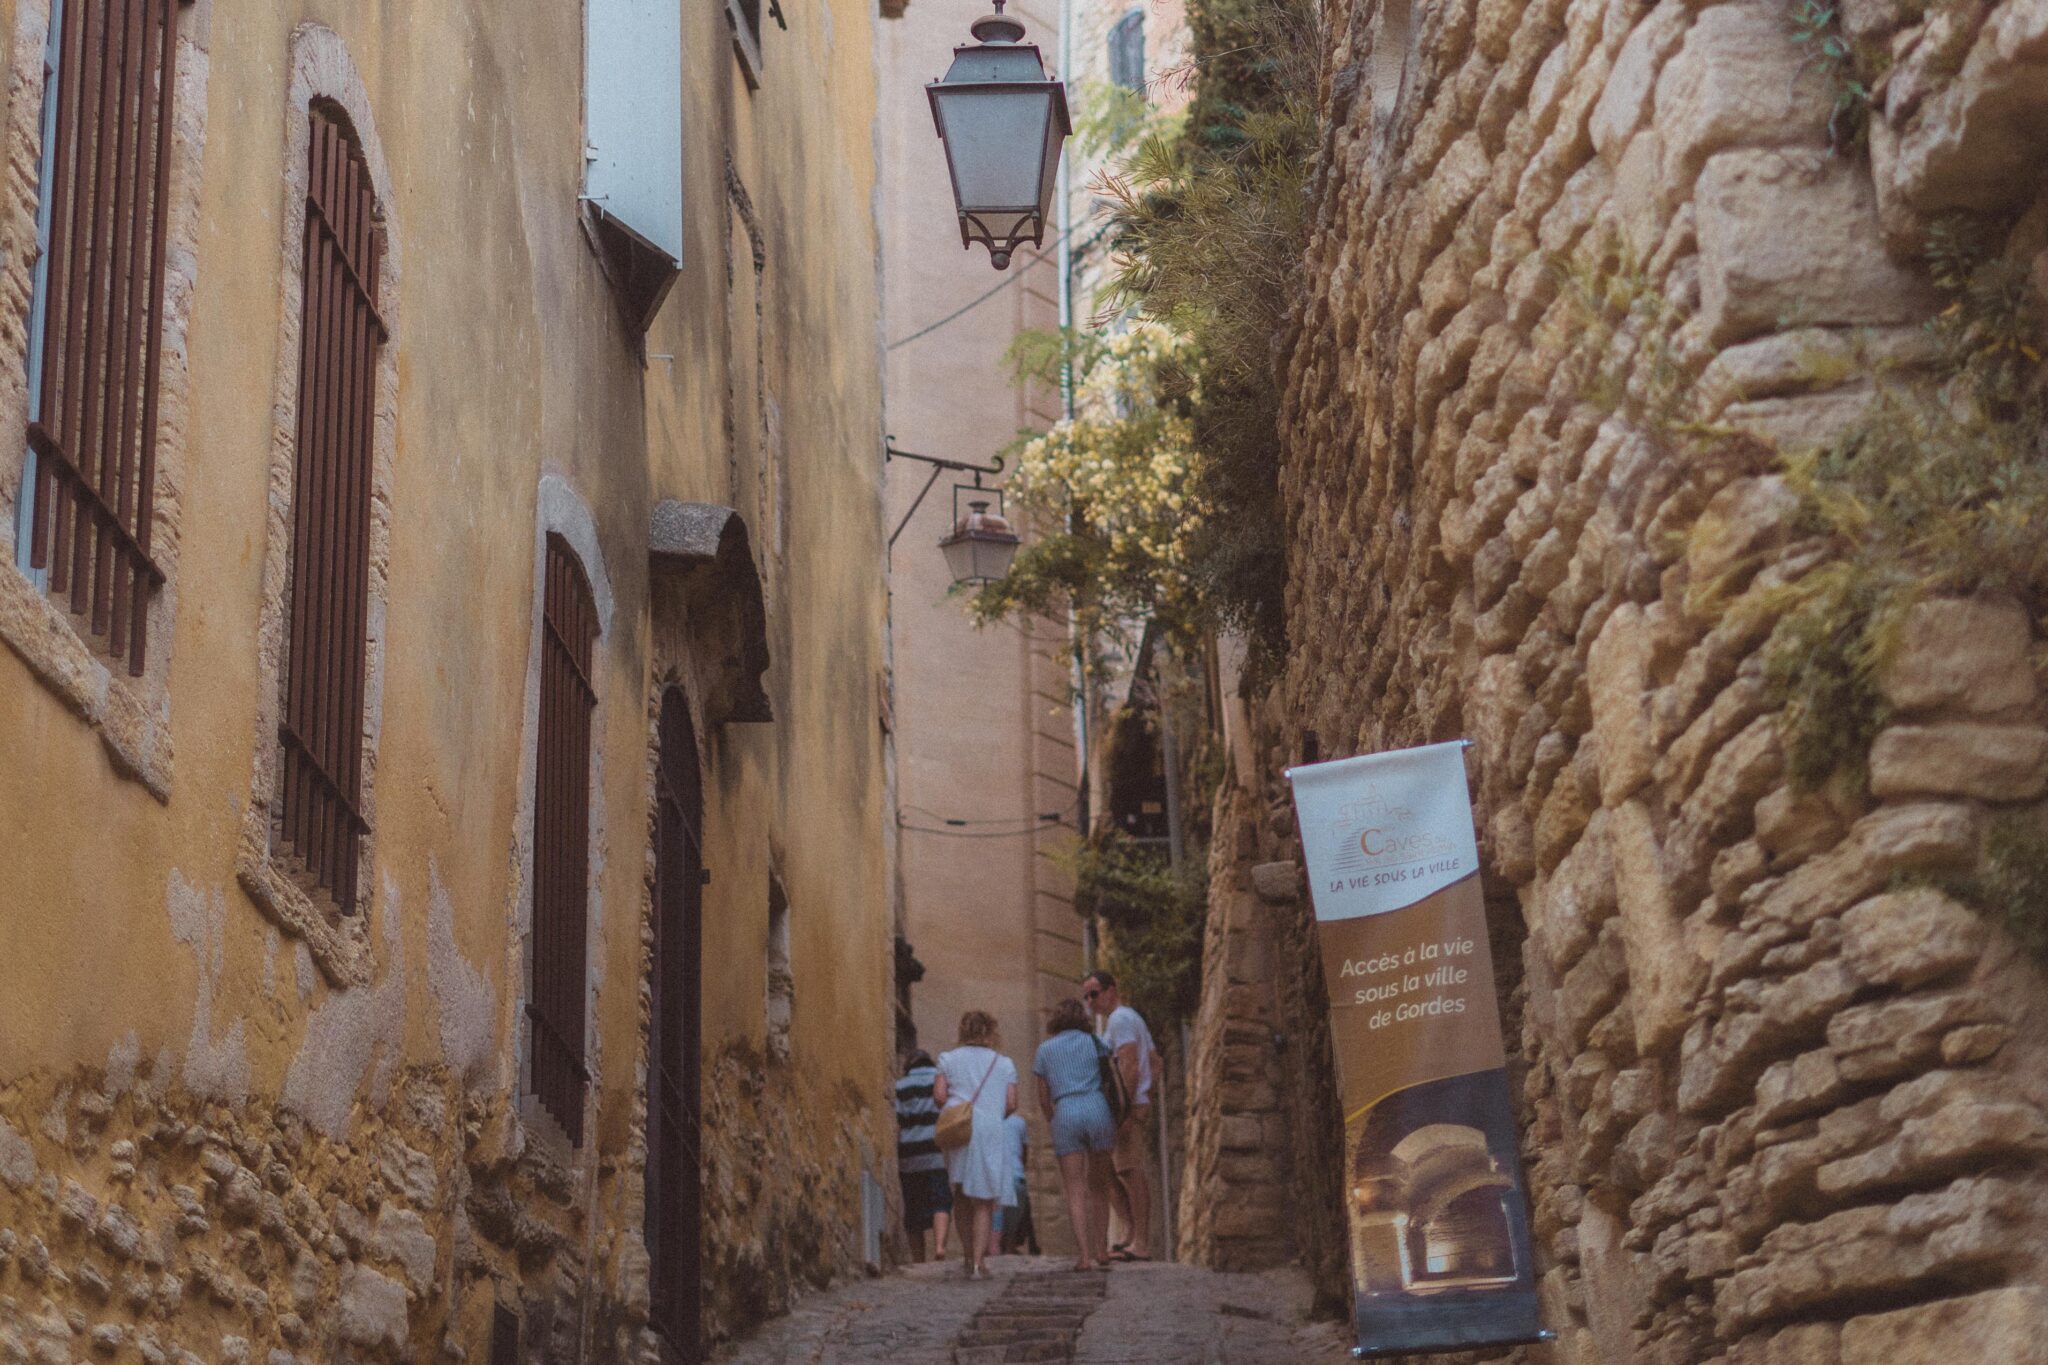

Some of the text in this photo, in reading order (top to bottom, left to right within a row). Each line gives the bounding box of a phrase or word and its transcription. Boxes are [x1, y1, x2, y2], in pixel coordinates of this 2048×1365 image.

[1361, 828, 1431, 855] Caves
[1330, 858, 1460, 893] LA VIE SOUS LA VILLE
[1339, 936, 1474, 978] Accès à la vie
[1355, 966, 1468, 1005] sous la ville
[1369, 995, 1466, 1030] de Gordes
